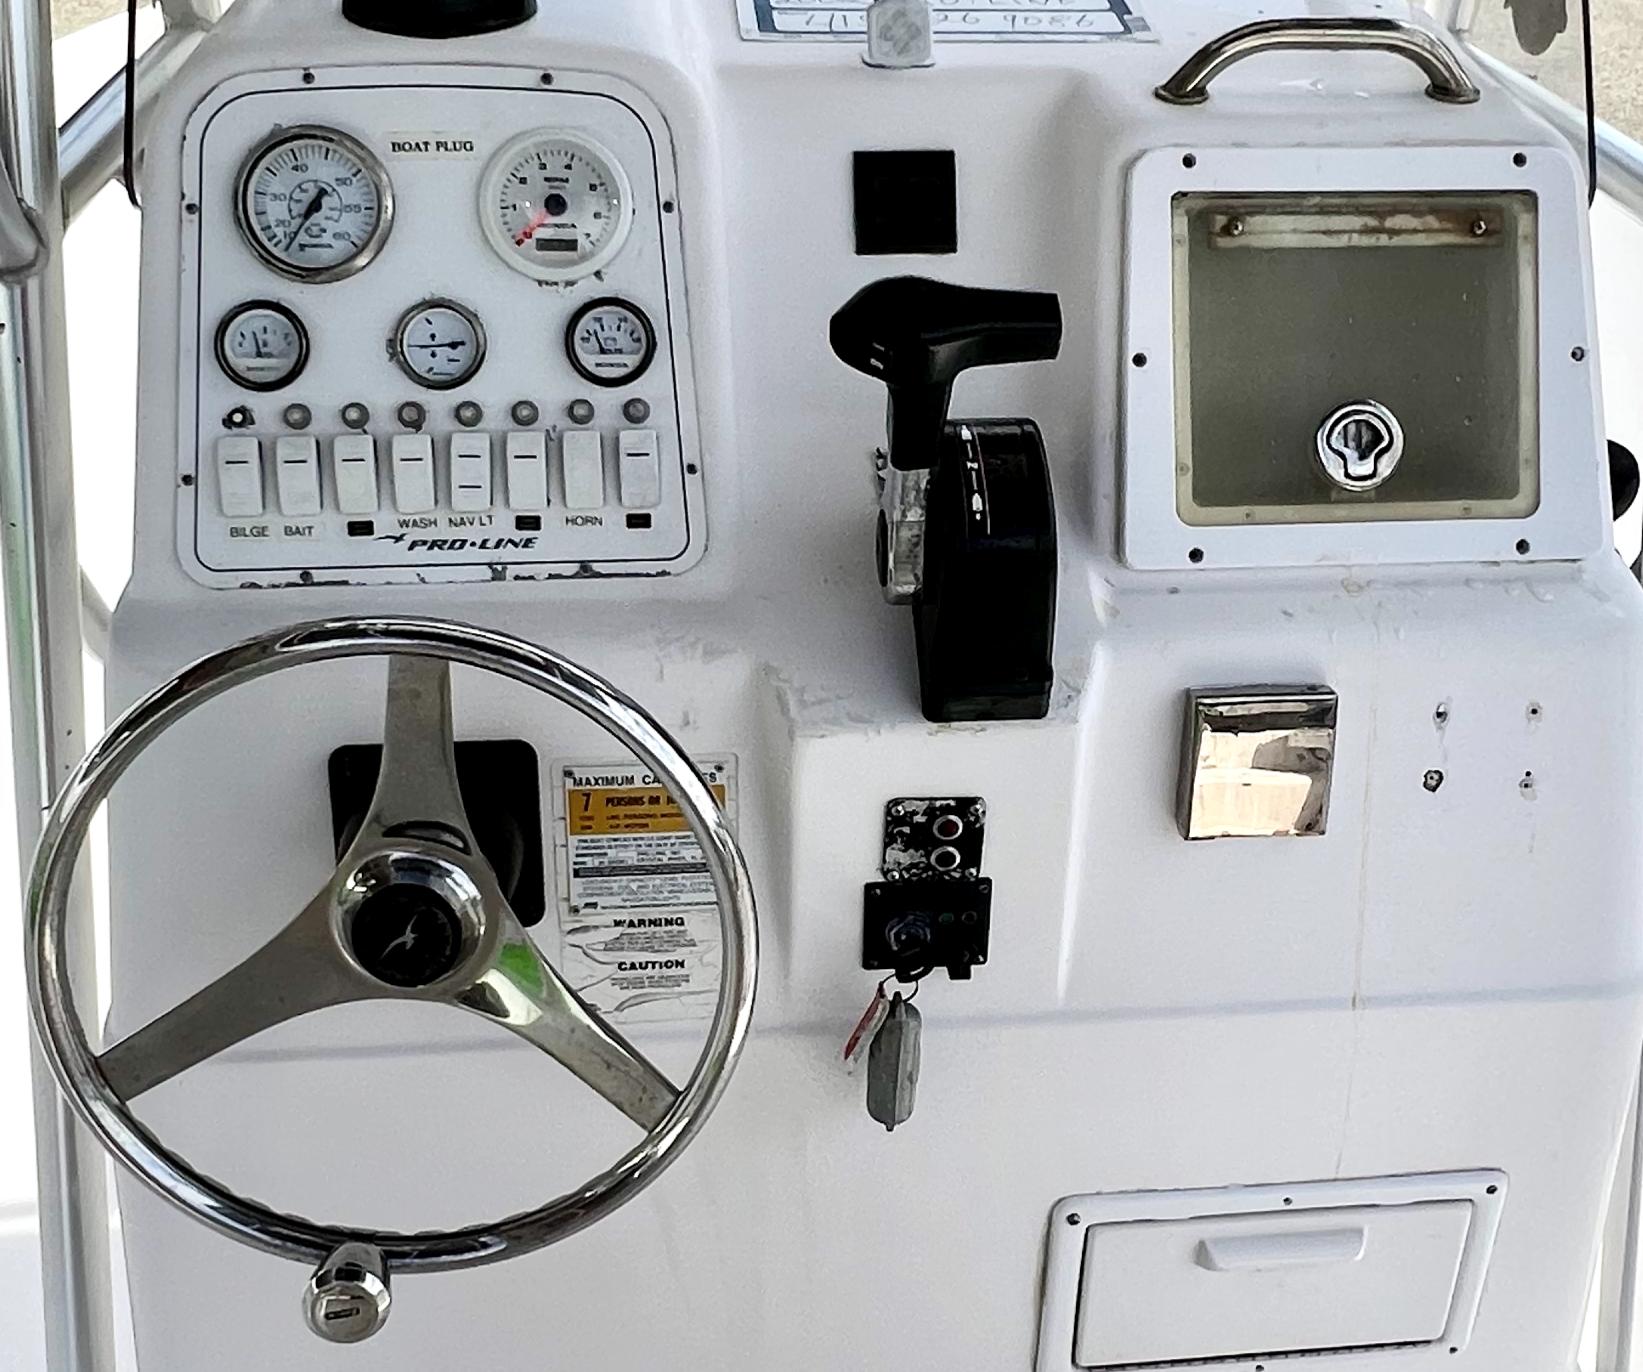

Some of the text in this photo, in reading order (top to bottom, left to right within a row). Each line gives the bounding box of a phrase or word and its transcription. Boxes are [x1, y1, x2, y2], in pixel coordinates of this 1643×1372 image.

[391, 141, 474, 153] BOAT PLUG
[397, 517, 438, 529] WASH
[448, 514, 495, 528] NAV LT
[565, 515, 603, 527] HORN
[229, 525, 270, 538] BILGE
[284, 525, 315, 537] BAIT
[573, 775, 635, 787] MAXIMUM
[582, 792, 592, 812] 7
[613, 916, 685, 929] WARNING
[617, 959, 686, 972] CAUTION
